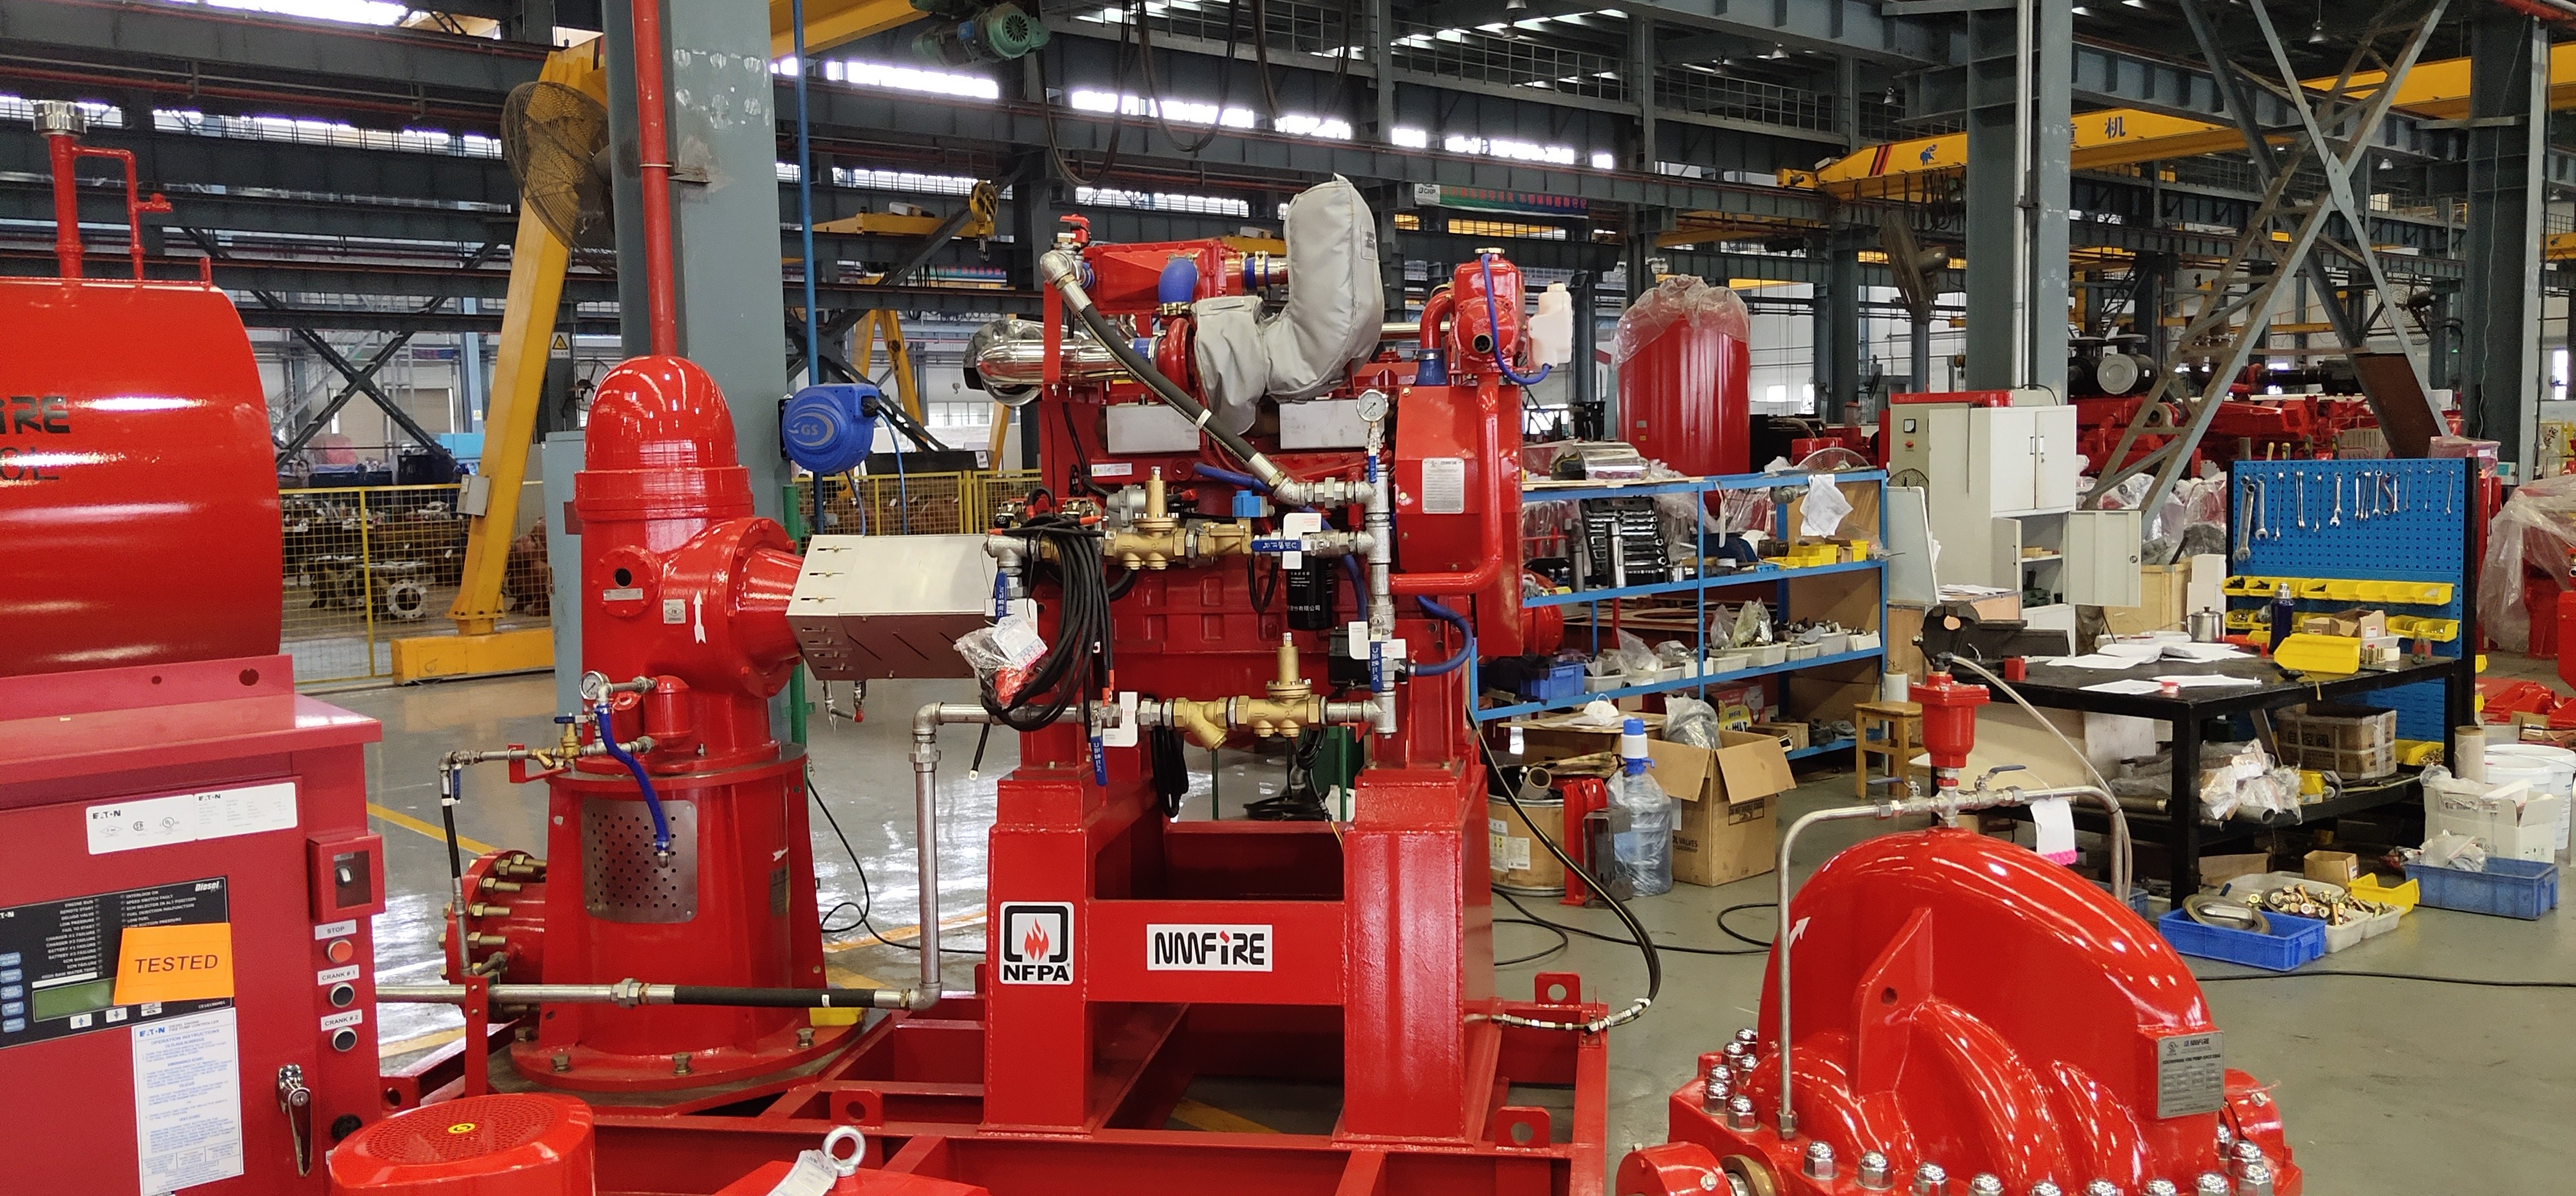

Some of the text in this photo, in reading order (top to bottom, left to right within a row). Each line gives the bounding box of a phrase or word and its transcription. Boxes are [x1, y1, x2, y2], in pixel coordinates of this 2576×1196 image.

[801, 424, 818, 436] GS
[195, 880, 220, 892] Diesel
[327, 926, 345, 934] STOP
[134, 954, 218, 974] TESTED
[321, 971, 345, 981] CRANK
[1004, 965, 1070, 981] NFPA
[325, 1016, 348, 1026] CRANK
